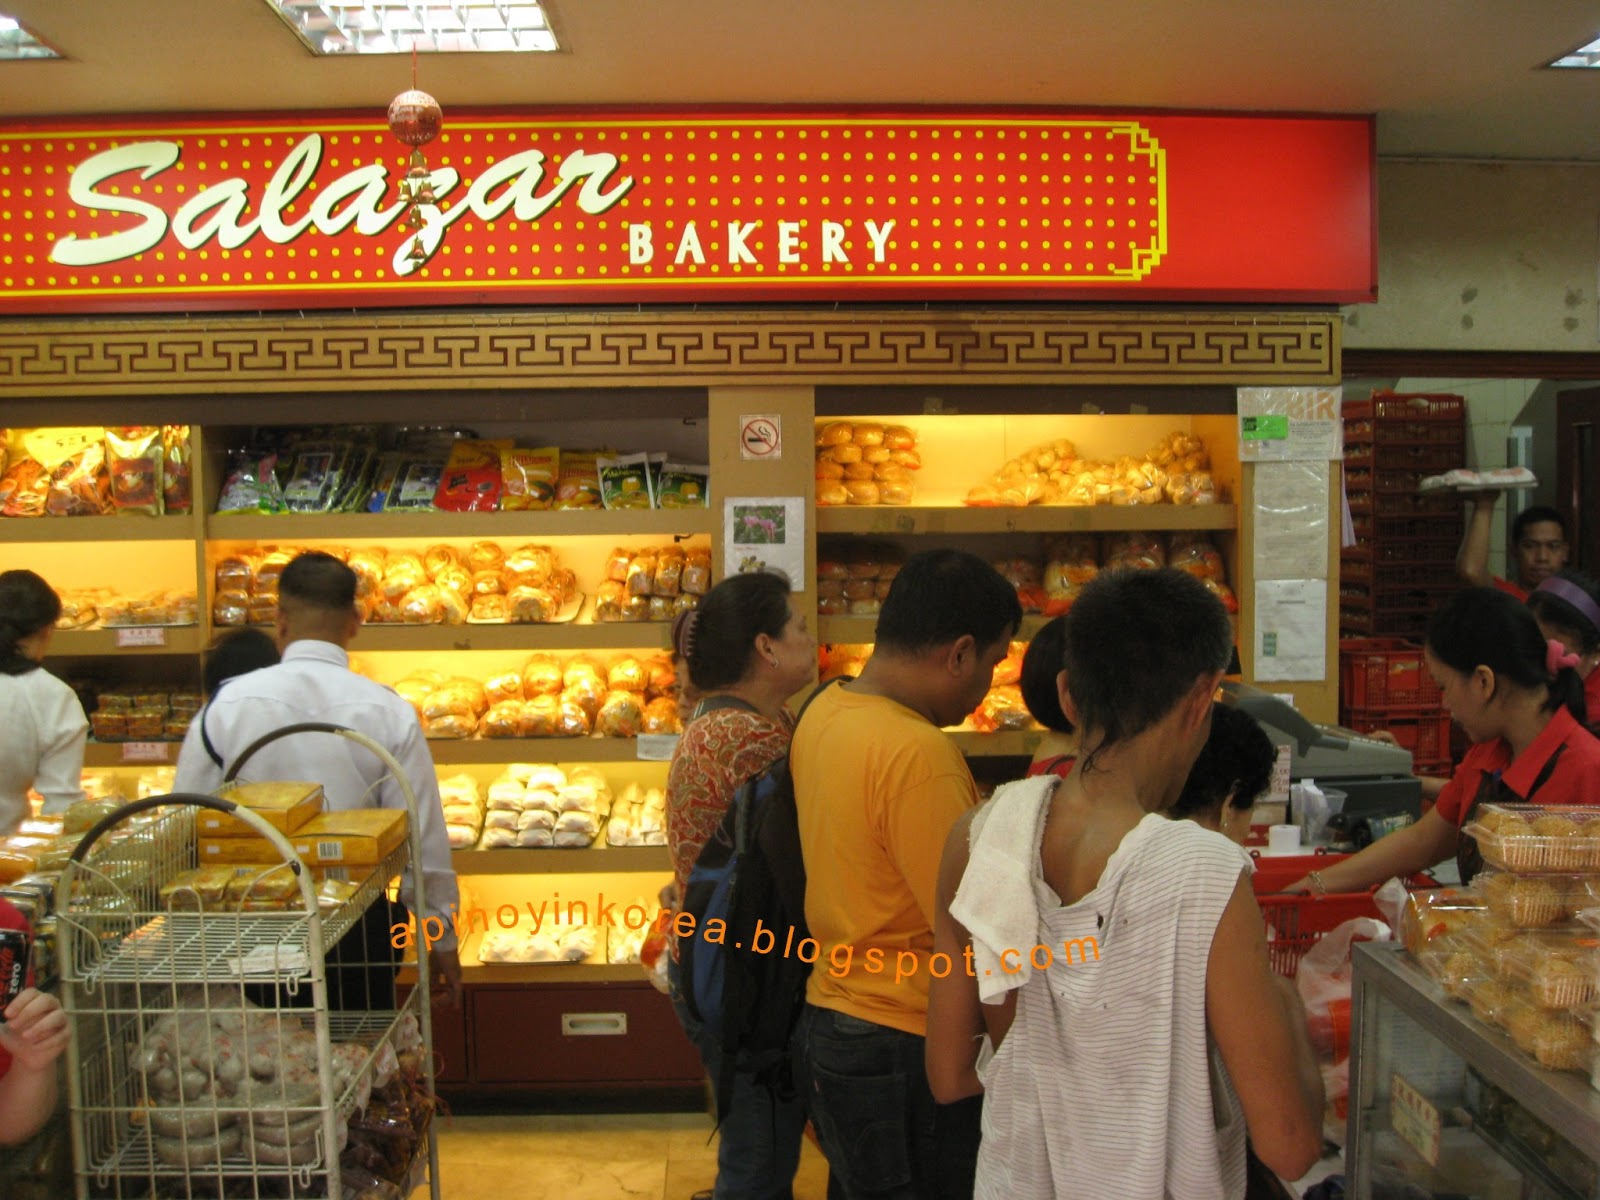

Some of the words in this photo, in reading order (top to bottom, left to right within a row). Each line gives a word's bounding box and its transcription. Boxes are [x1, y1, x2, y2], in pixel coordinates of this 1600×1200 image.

[51, 132, 633, 277] Salazar
[629, 222, 894, 264] BAKERY
[1286, 391, 1336, 420] BIR
[9, 963, 22, 995] zero
